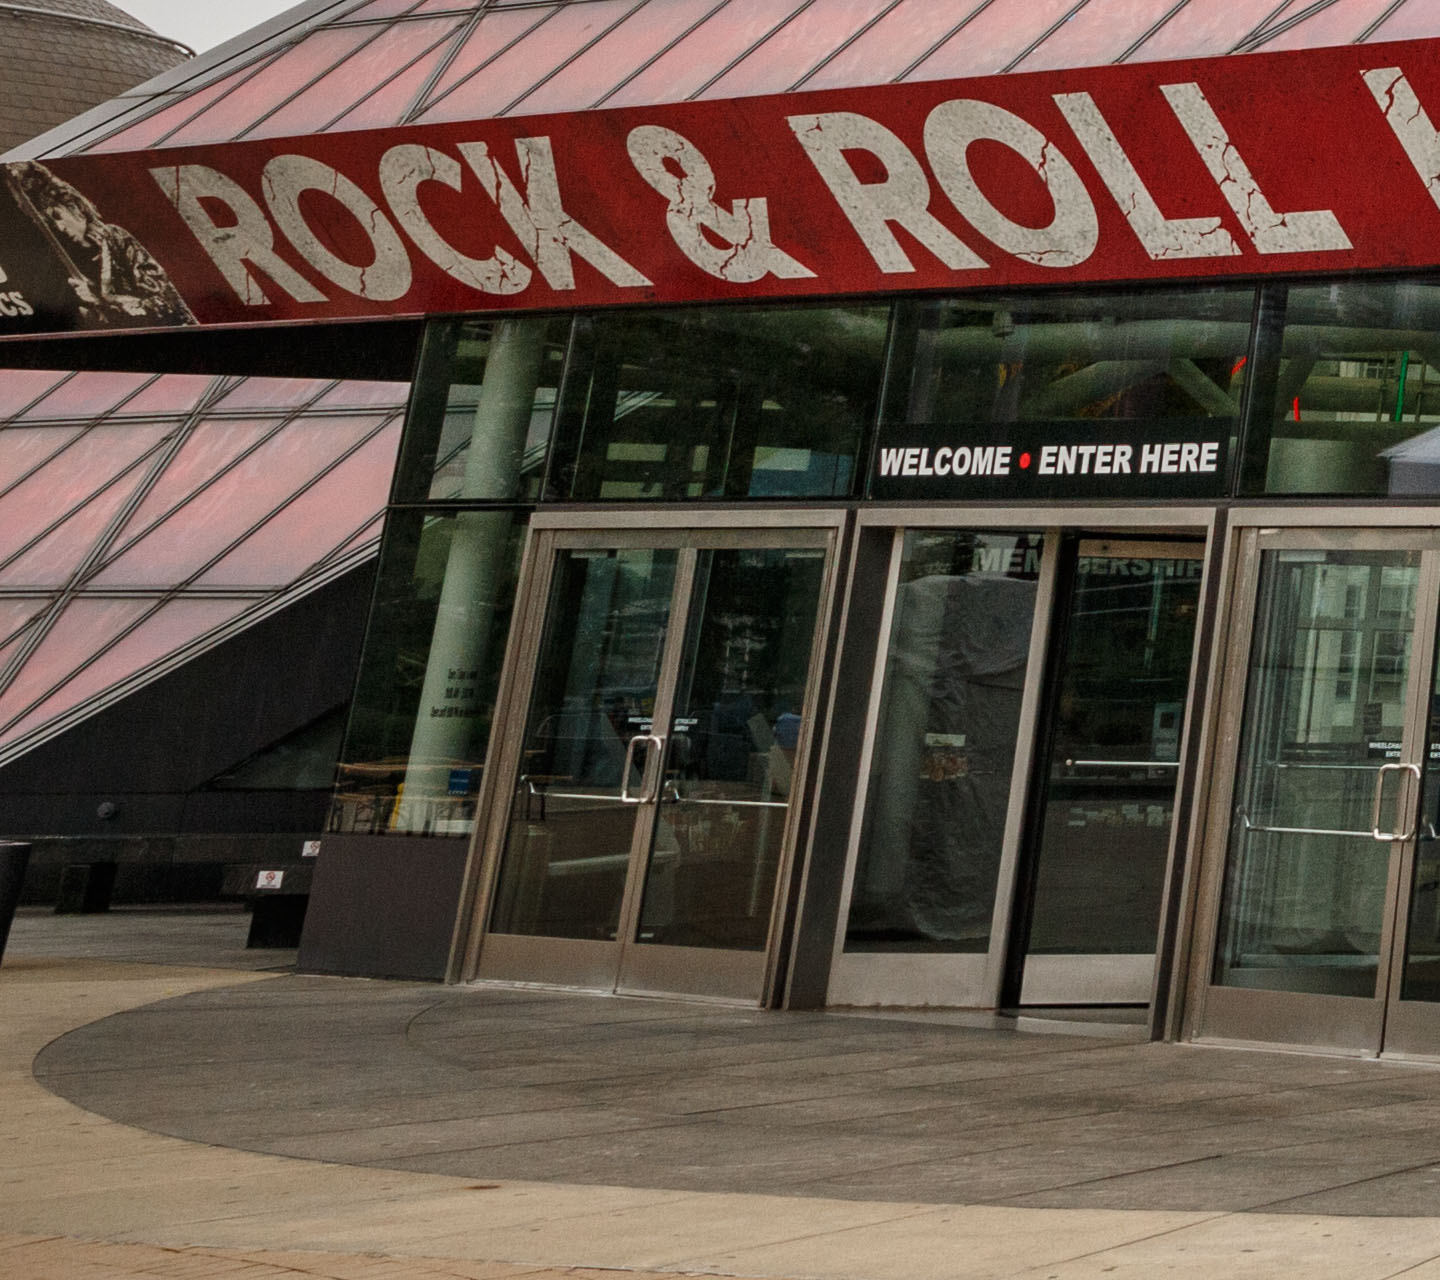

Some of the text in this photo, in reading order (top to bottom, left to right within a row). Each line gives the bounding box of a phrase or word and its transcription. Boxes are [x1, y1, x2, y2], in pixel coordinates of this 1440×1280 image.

[148, 136, 652, 306] ROCK
[626, 124, 817, 284] &
[785, 82, 1354, 275] ROLL
[880, 442, 1219, 476] WELCOME ENTER HERE
